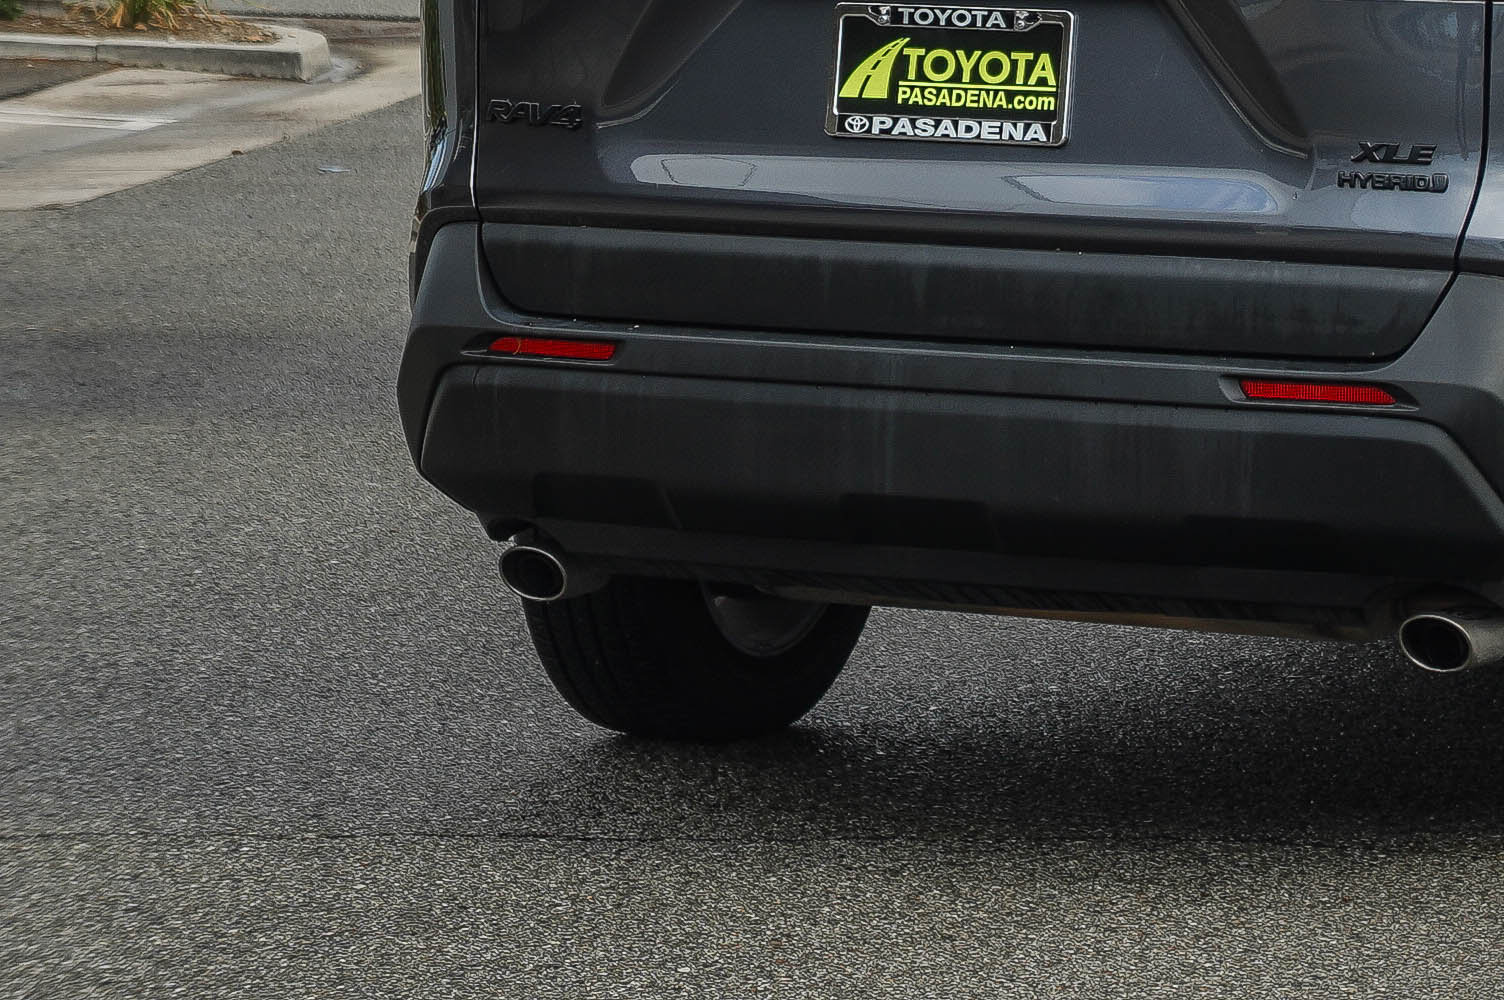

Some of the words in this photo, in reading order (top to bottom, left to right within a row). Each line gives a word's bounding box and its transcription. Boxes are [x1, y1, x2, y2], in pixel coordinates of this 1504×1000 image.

[898, 7, 1007, 28] TOYOTA
[902, 48, 1057, 86] TOYOTA
[897, 87, 1055, 111] PASADENA.com
[871, 116, 1047, 142] PASADENA
[1350, 141, 1437, 165] XLE
[1337, 171, 1430, 192] HYBRID
